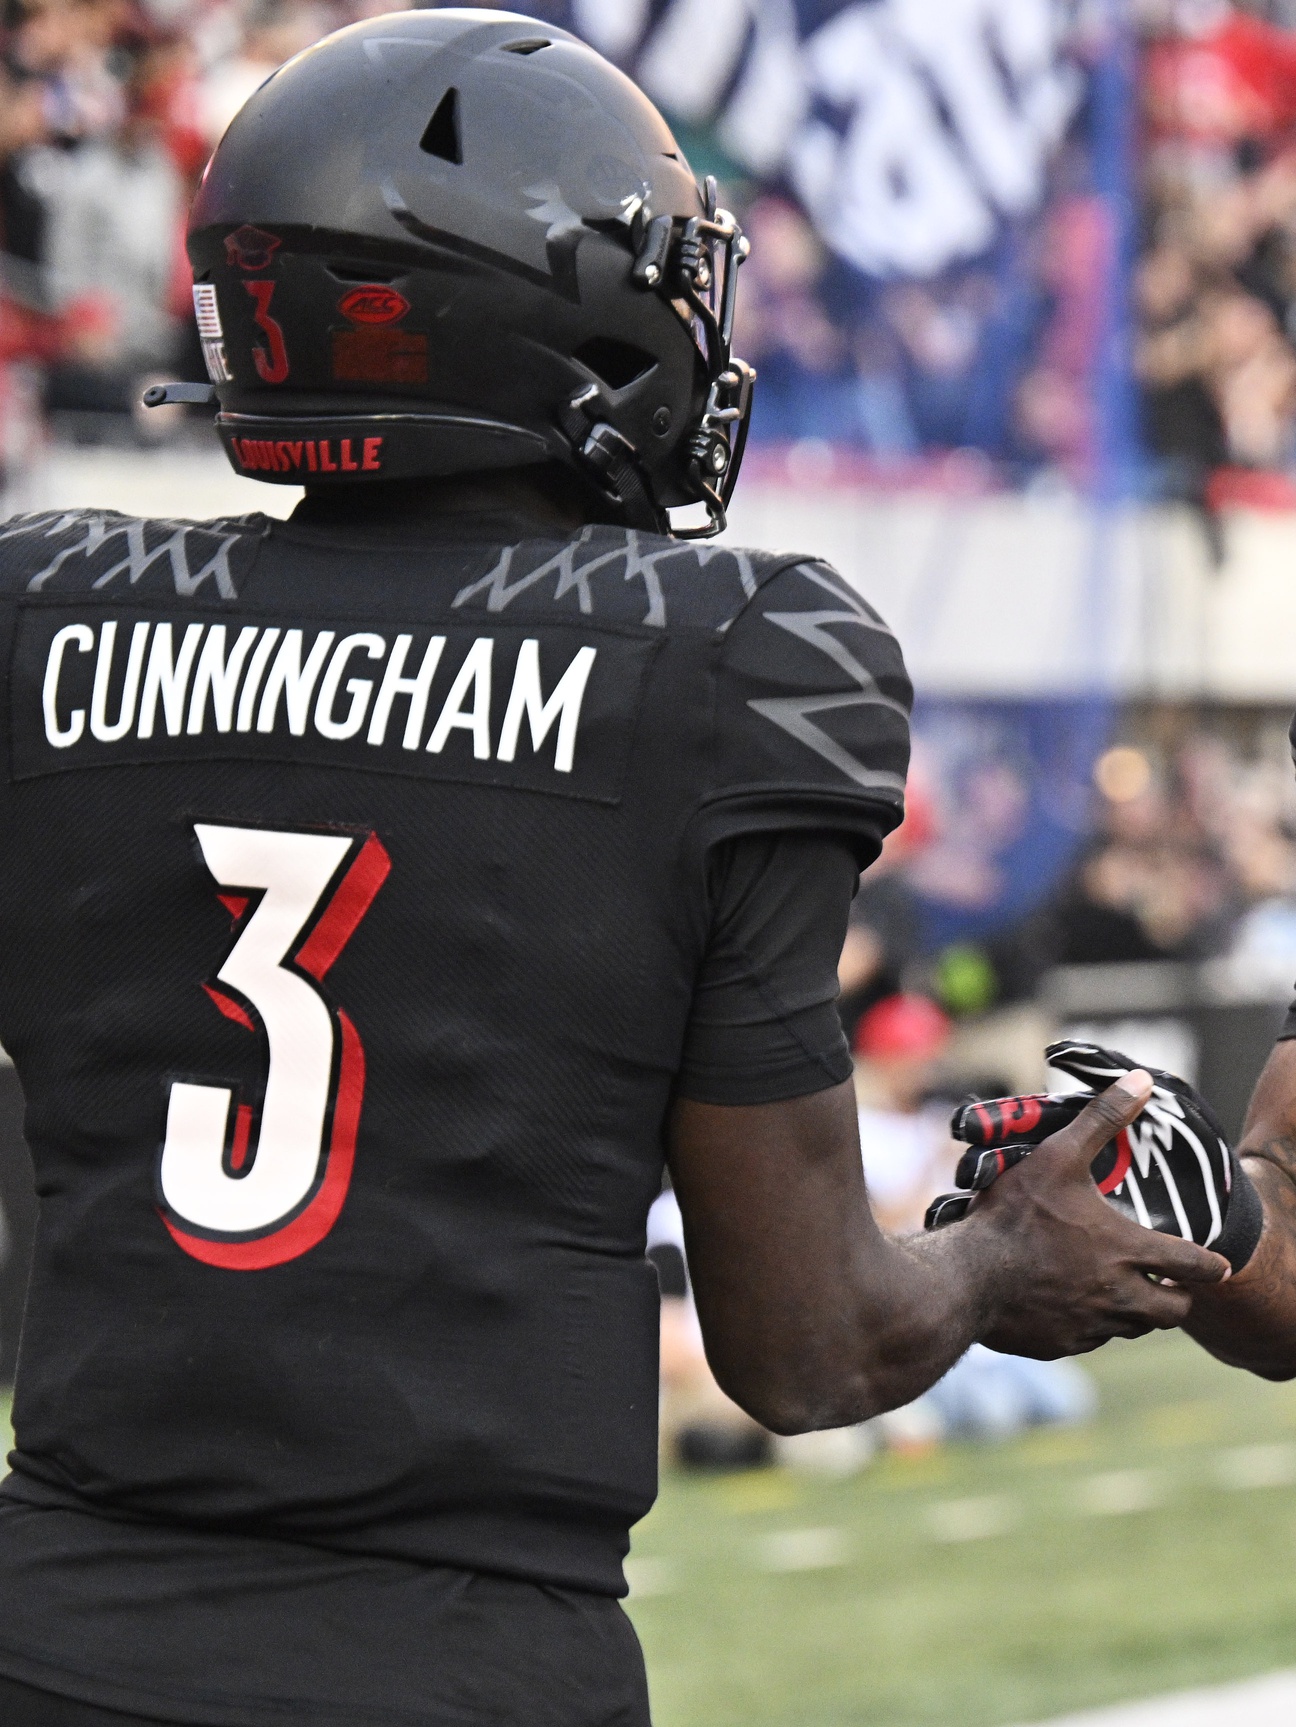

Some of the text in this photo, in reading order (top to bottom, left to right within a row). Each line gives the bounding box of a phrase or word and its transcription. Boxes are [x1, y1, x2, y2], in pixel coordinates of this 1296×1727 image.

[242, 280, 289, 383] 3
[231, 437, 383, 472] LOUISVILLE
[43, 620, 597, 773] CUNNINGHAM
[156, 822, 391, 1270] 3
